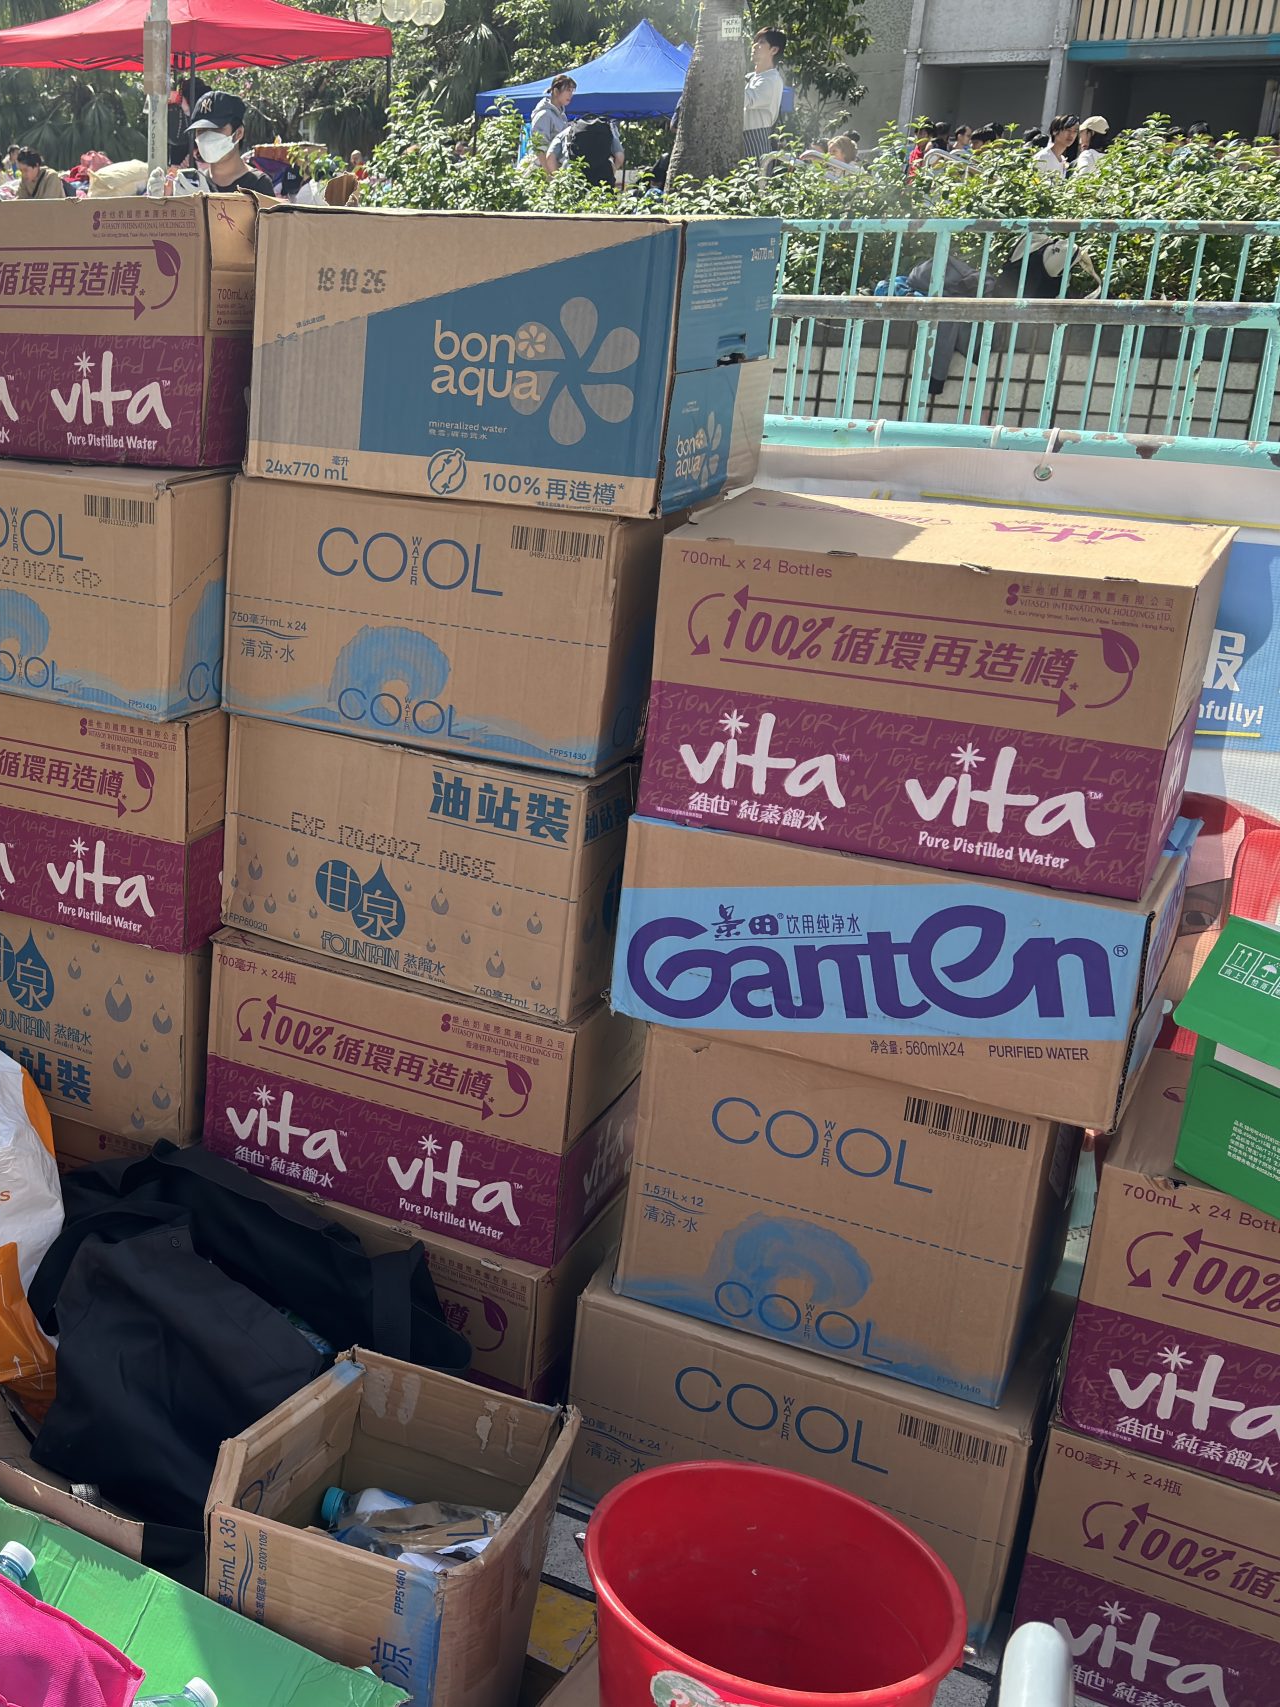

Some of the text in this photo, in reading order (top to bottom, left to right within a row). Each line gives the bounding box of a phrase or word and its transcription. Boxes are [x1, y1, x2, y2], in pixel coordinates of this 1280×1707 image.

[317, 267, 387, 294] 18 10 26
[433, 319, 516, 365] bon
[50, 350, 172, 430] vita
[431, 365, 541, 406] aqua
[66, 431, 158, 450] Pure Distilled Water
[429, 420, 507, 434] mineralized water
[265, 459, 348, 481] 24x770 mL
[484, 472, 616, 506] 100% 再造樽
[317, 526, 503, 596] COOL
[410, 536, 422, 586] WATER
[680, 549, 731, 569] 700mL
[752, 557, 772, 573] 24
[778, 560, 833, 579] Bottles
[295, 620, 307, 631] 24
[549, 747, 587, 761] FPP51430
[679, 709, 846, 809] vita
[429, 770, 572, 844] 油站裝
[904, 742, 1096, 849] vita
[291, 811, 326, 841] EXP
[918, 831, 1069, 871] Pure Distilled Water
[47, 836, 155, 918] vita
[58, 901, 142, 933] Pure Distilled Water
[786, 913, 861, 936] 饮用纯净水
[627, 905, 1116, 1020] Ganten
[452, 1027, 474, 1038] VITASOY
[475, 1033, 519, 1049] INTERNATIONAL
[520, 1042, 551, 1057] HOLDINGS
[988, 1044, 1042, 1061] PURIFIED
[1045, 1045, 1089, 1062] WATER
[226, 1084, 348, 1172] vita
[711, 1096, 934, 1194] COOL
[387, 1133, 521, 1226] vita
[399, 1197, 504, 1240] Pure Distilled Water
[714, 1280, 893, 1365] COOL
[674, 1366, 889, 1476] COOL
[780, 1395, 795, 1441] WATER
[220, 1517, 237, 1538] 35
[394, 1569, 407, 1616] FPP51460
